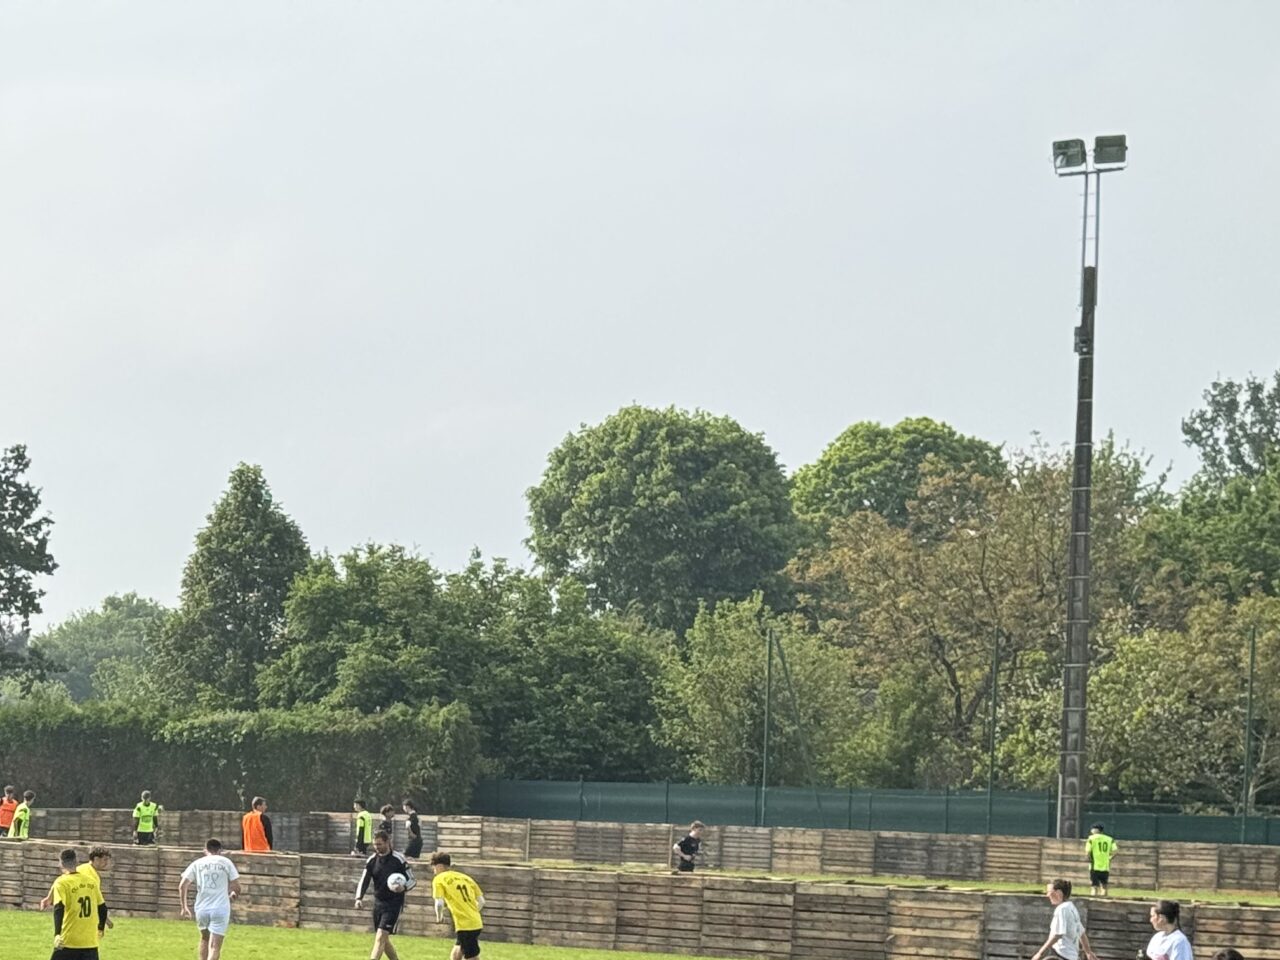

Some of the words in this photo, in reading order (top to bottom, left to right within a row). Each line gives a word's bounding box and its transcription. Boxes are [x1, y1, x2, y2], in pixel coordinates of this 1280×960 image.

[1098, 841, 1108, 853] 10
[456, 884, 471, 902] 11
[77, 895, 92, 918] 10
